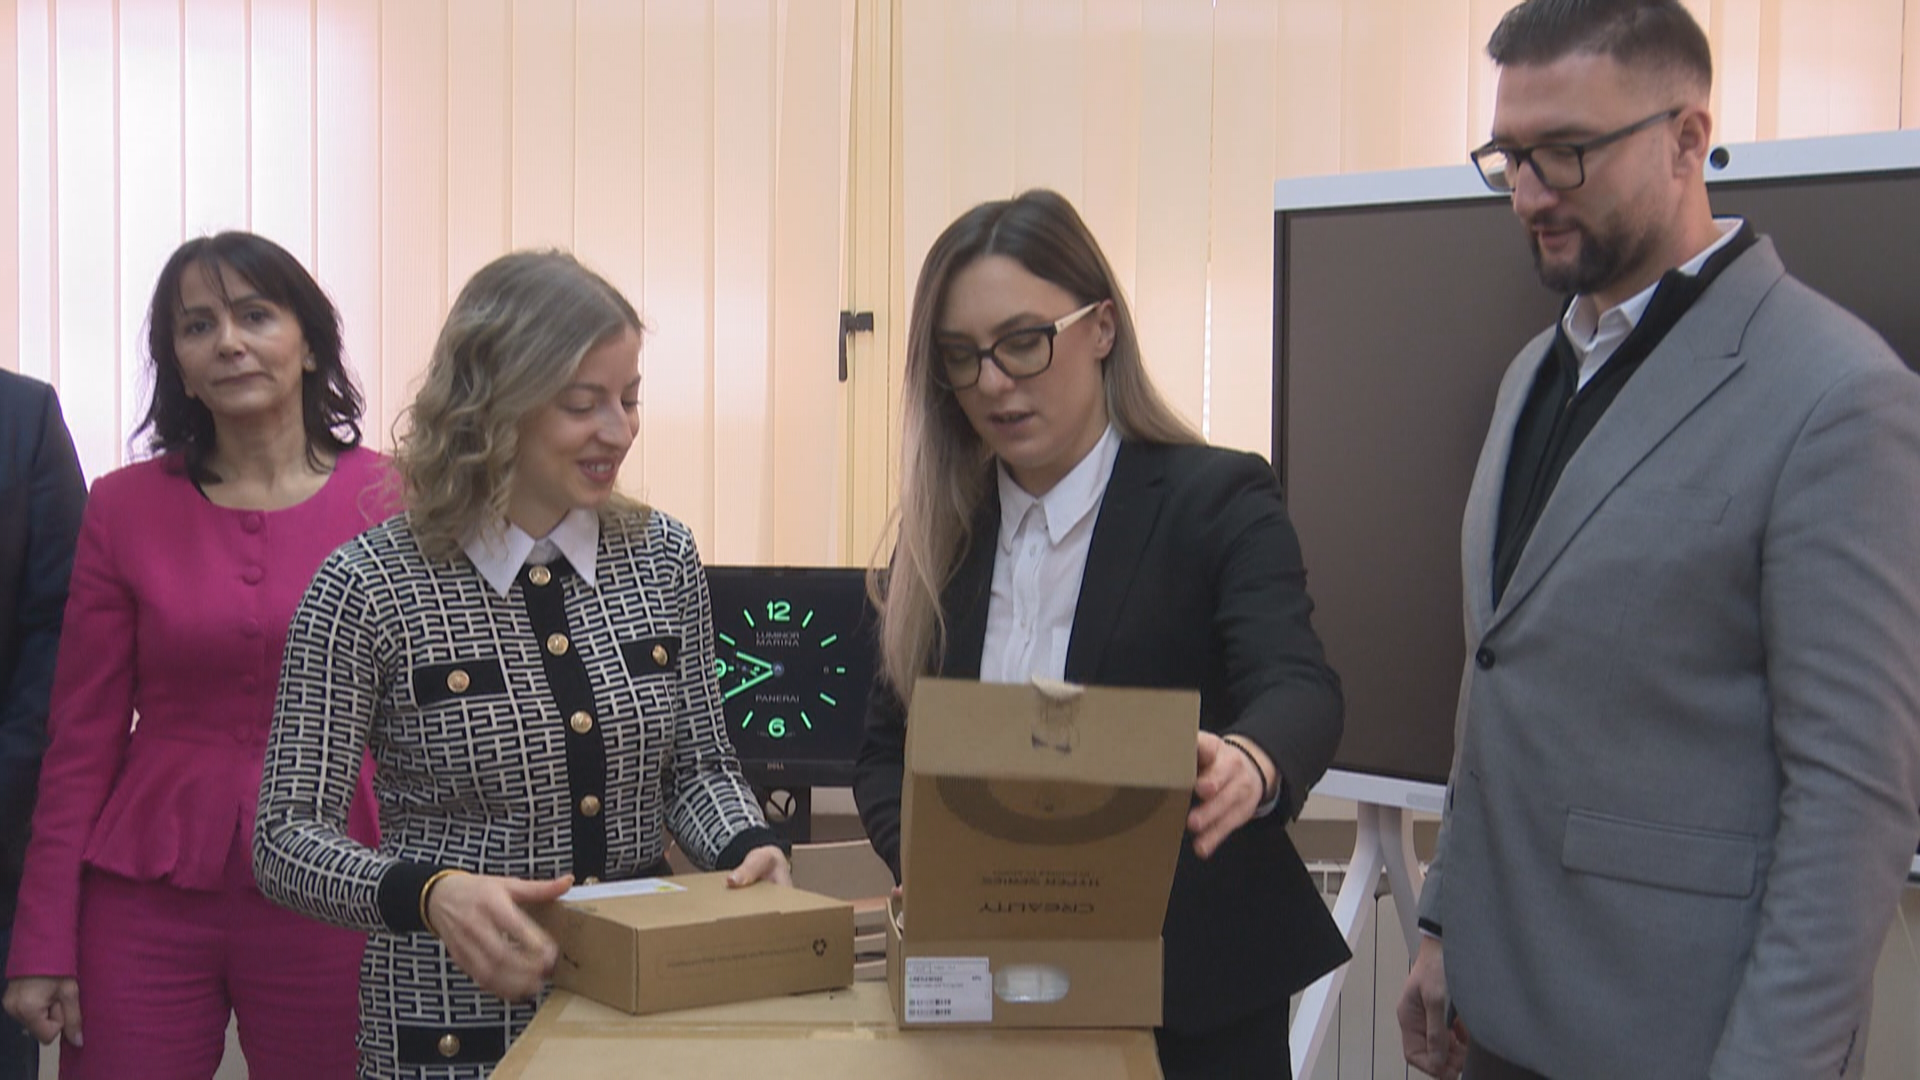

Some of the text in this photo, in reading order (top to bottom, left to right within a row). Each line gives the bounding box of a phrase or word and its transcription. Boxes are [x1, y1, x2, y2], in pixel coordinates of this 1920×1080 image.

[766, 600, 791, 621] 12
[755, 632, 800, 640] LUMINOR
[755, 694, 800, 703] PANERAI
[768, 717, 786, 738] 6
[979, 902, 1095, 913] CREALITY
